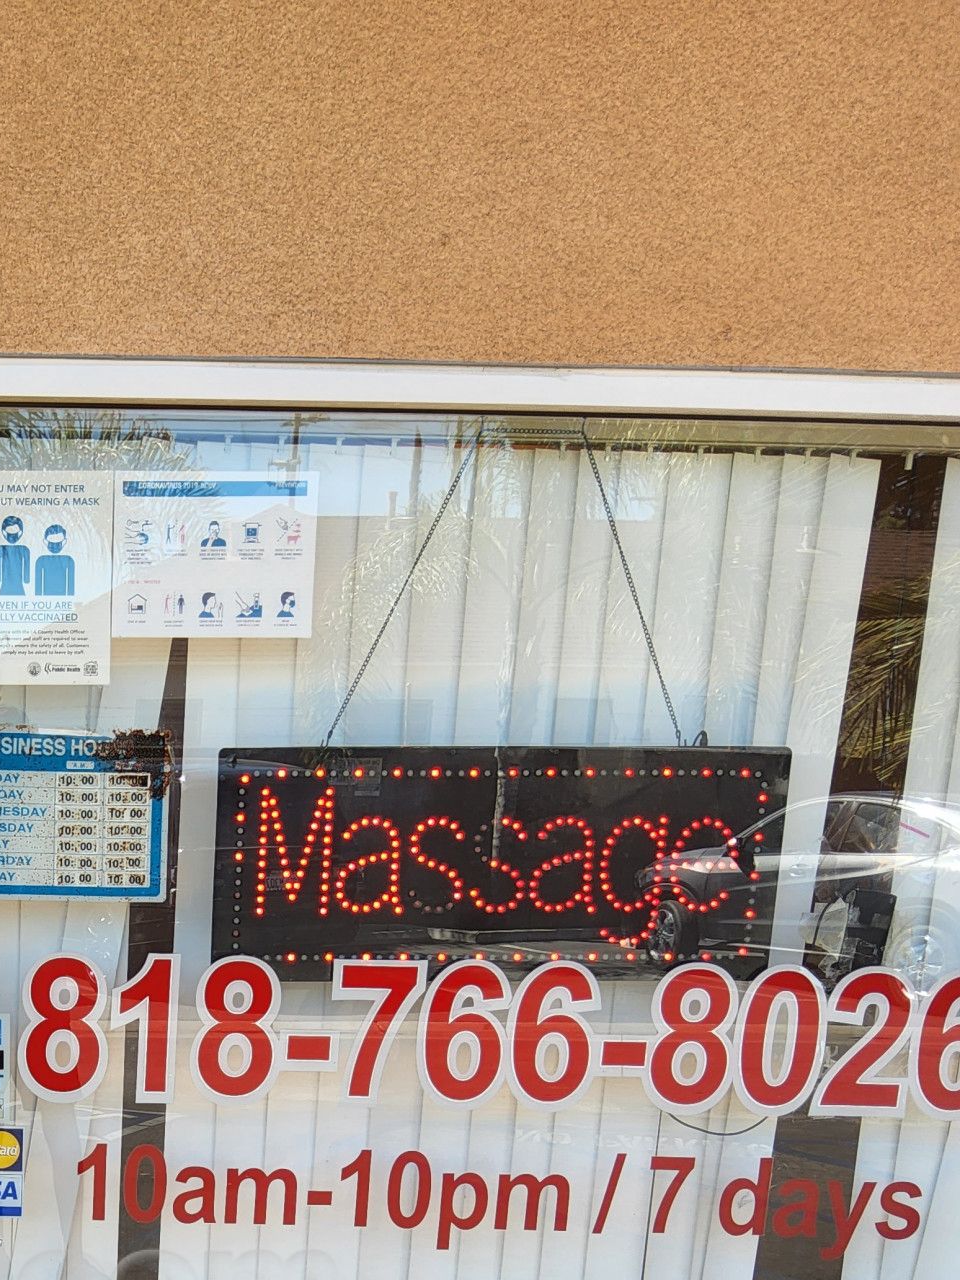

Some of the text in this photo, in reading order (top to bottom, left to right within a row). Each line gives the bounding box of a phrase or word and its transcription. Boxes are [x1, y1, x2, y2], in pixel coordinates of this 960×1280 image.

[7, 484, 28, 492] MAY
[31, 484, 51, 492] NOT
[54, 484, 84, 492] ENTER
[16, 497, 60, 506] WEARING
[73, 498, 100, 506] MASK
[20, 601, 28, 610] IF
[30, 601, 51, 610] YOU
[53, 601, 72, 610] ARE
[19, 613, 78, 621] VACCINATED
[253, 785, 742, 948] Massage
[22, 954, 960, 1114] 818-766-8026
[76, 1143, 923, 1261] 10am-10pm / 7 days
